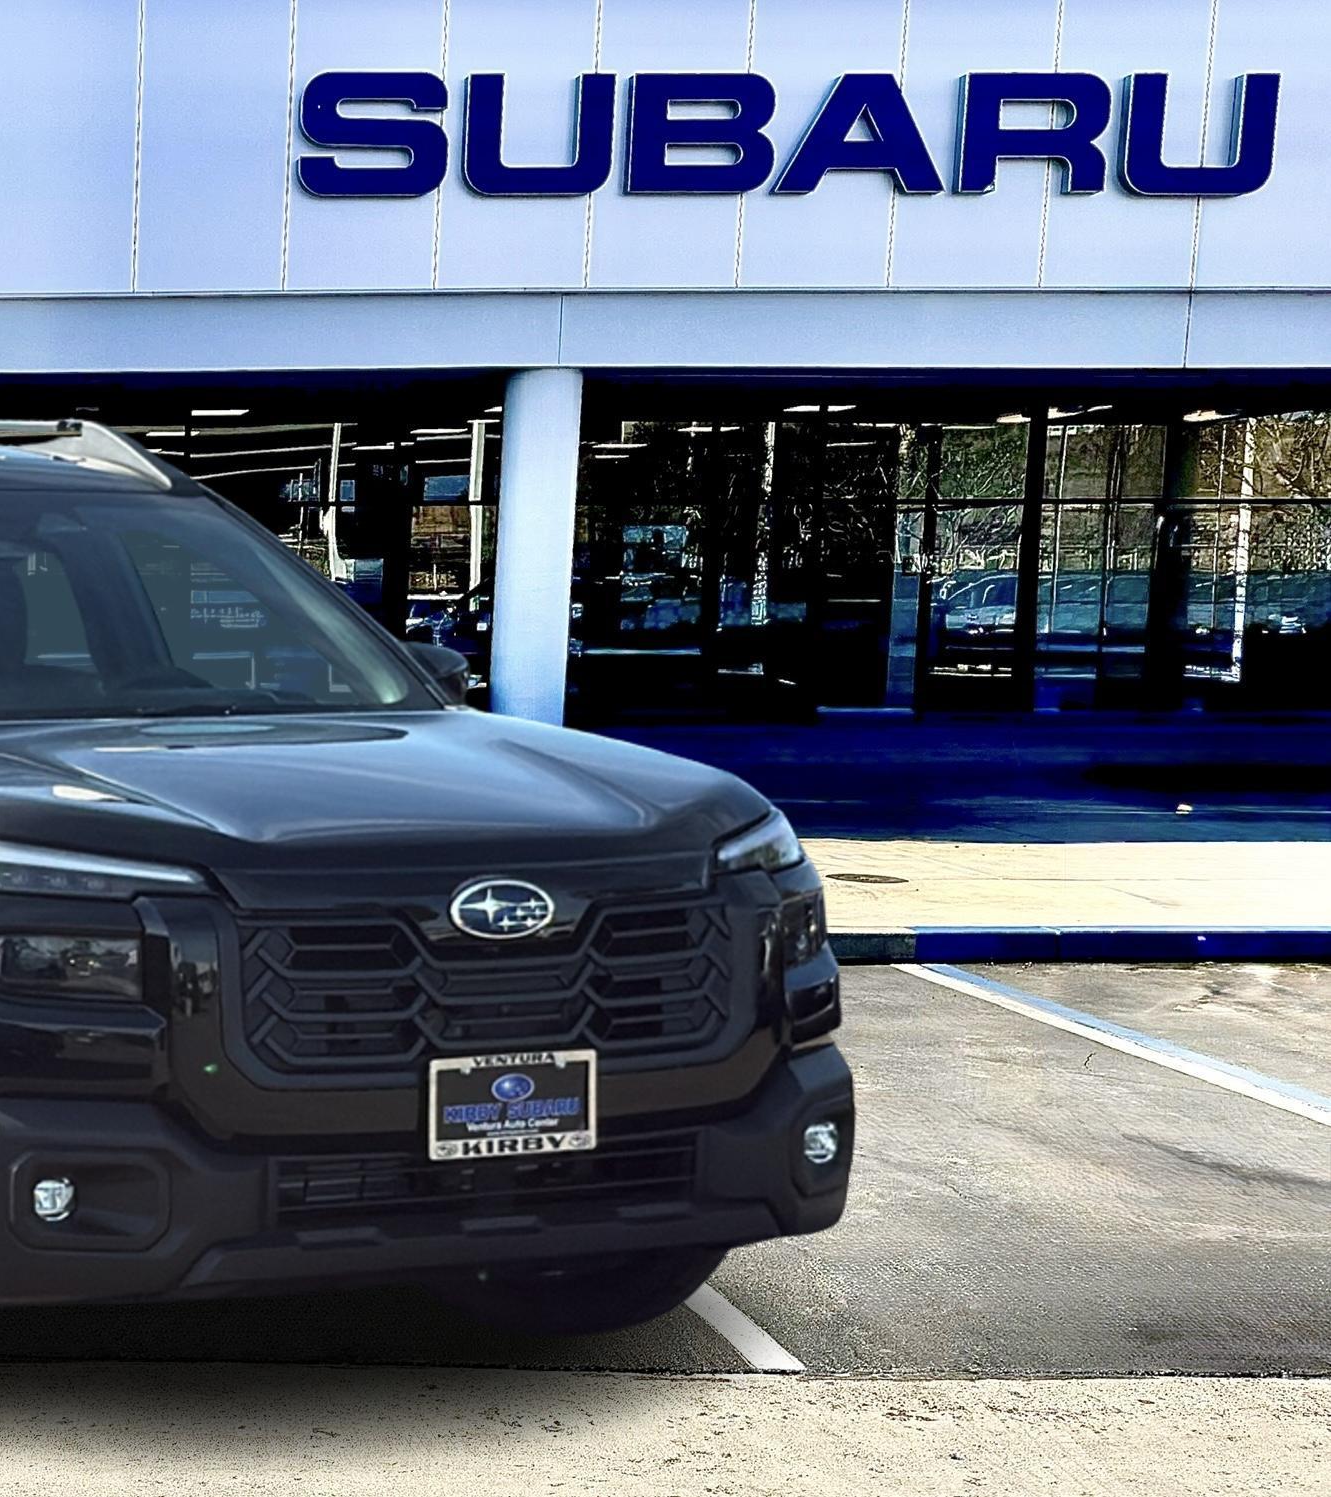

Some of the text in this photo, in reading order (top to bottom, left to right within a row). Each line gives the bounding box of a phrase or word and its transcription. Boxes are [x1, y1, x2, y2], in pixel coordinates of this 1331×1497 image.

[296, 69, 1283, 197] SUBARU
[472, 1052, 556, 1067] VENTURA
[443, 1097, 580, 1123] KIRBY SUBARU
[466, 1117, 559, 1132] Ventura Auto Center
[462, 1136, 566, 1156] KIRBY
